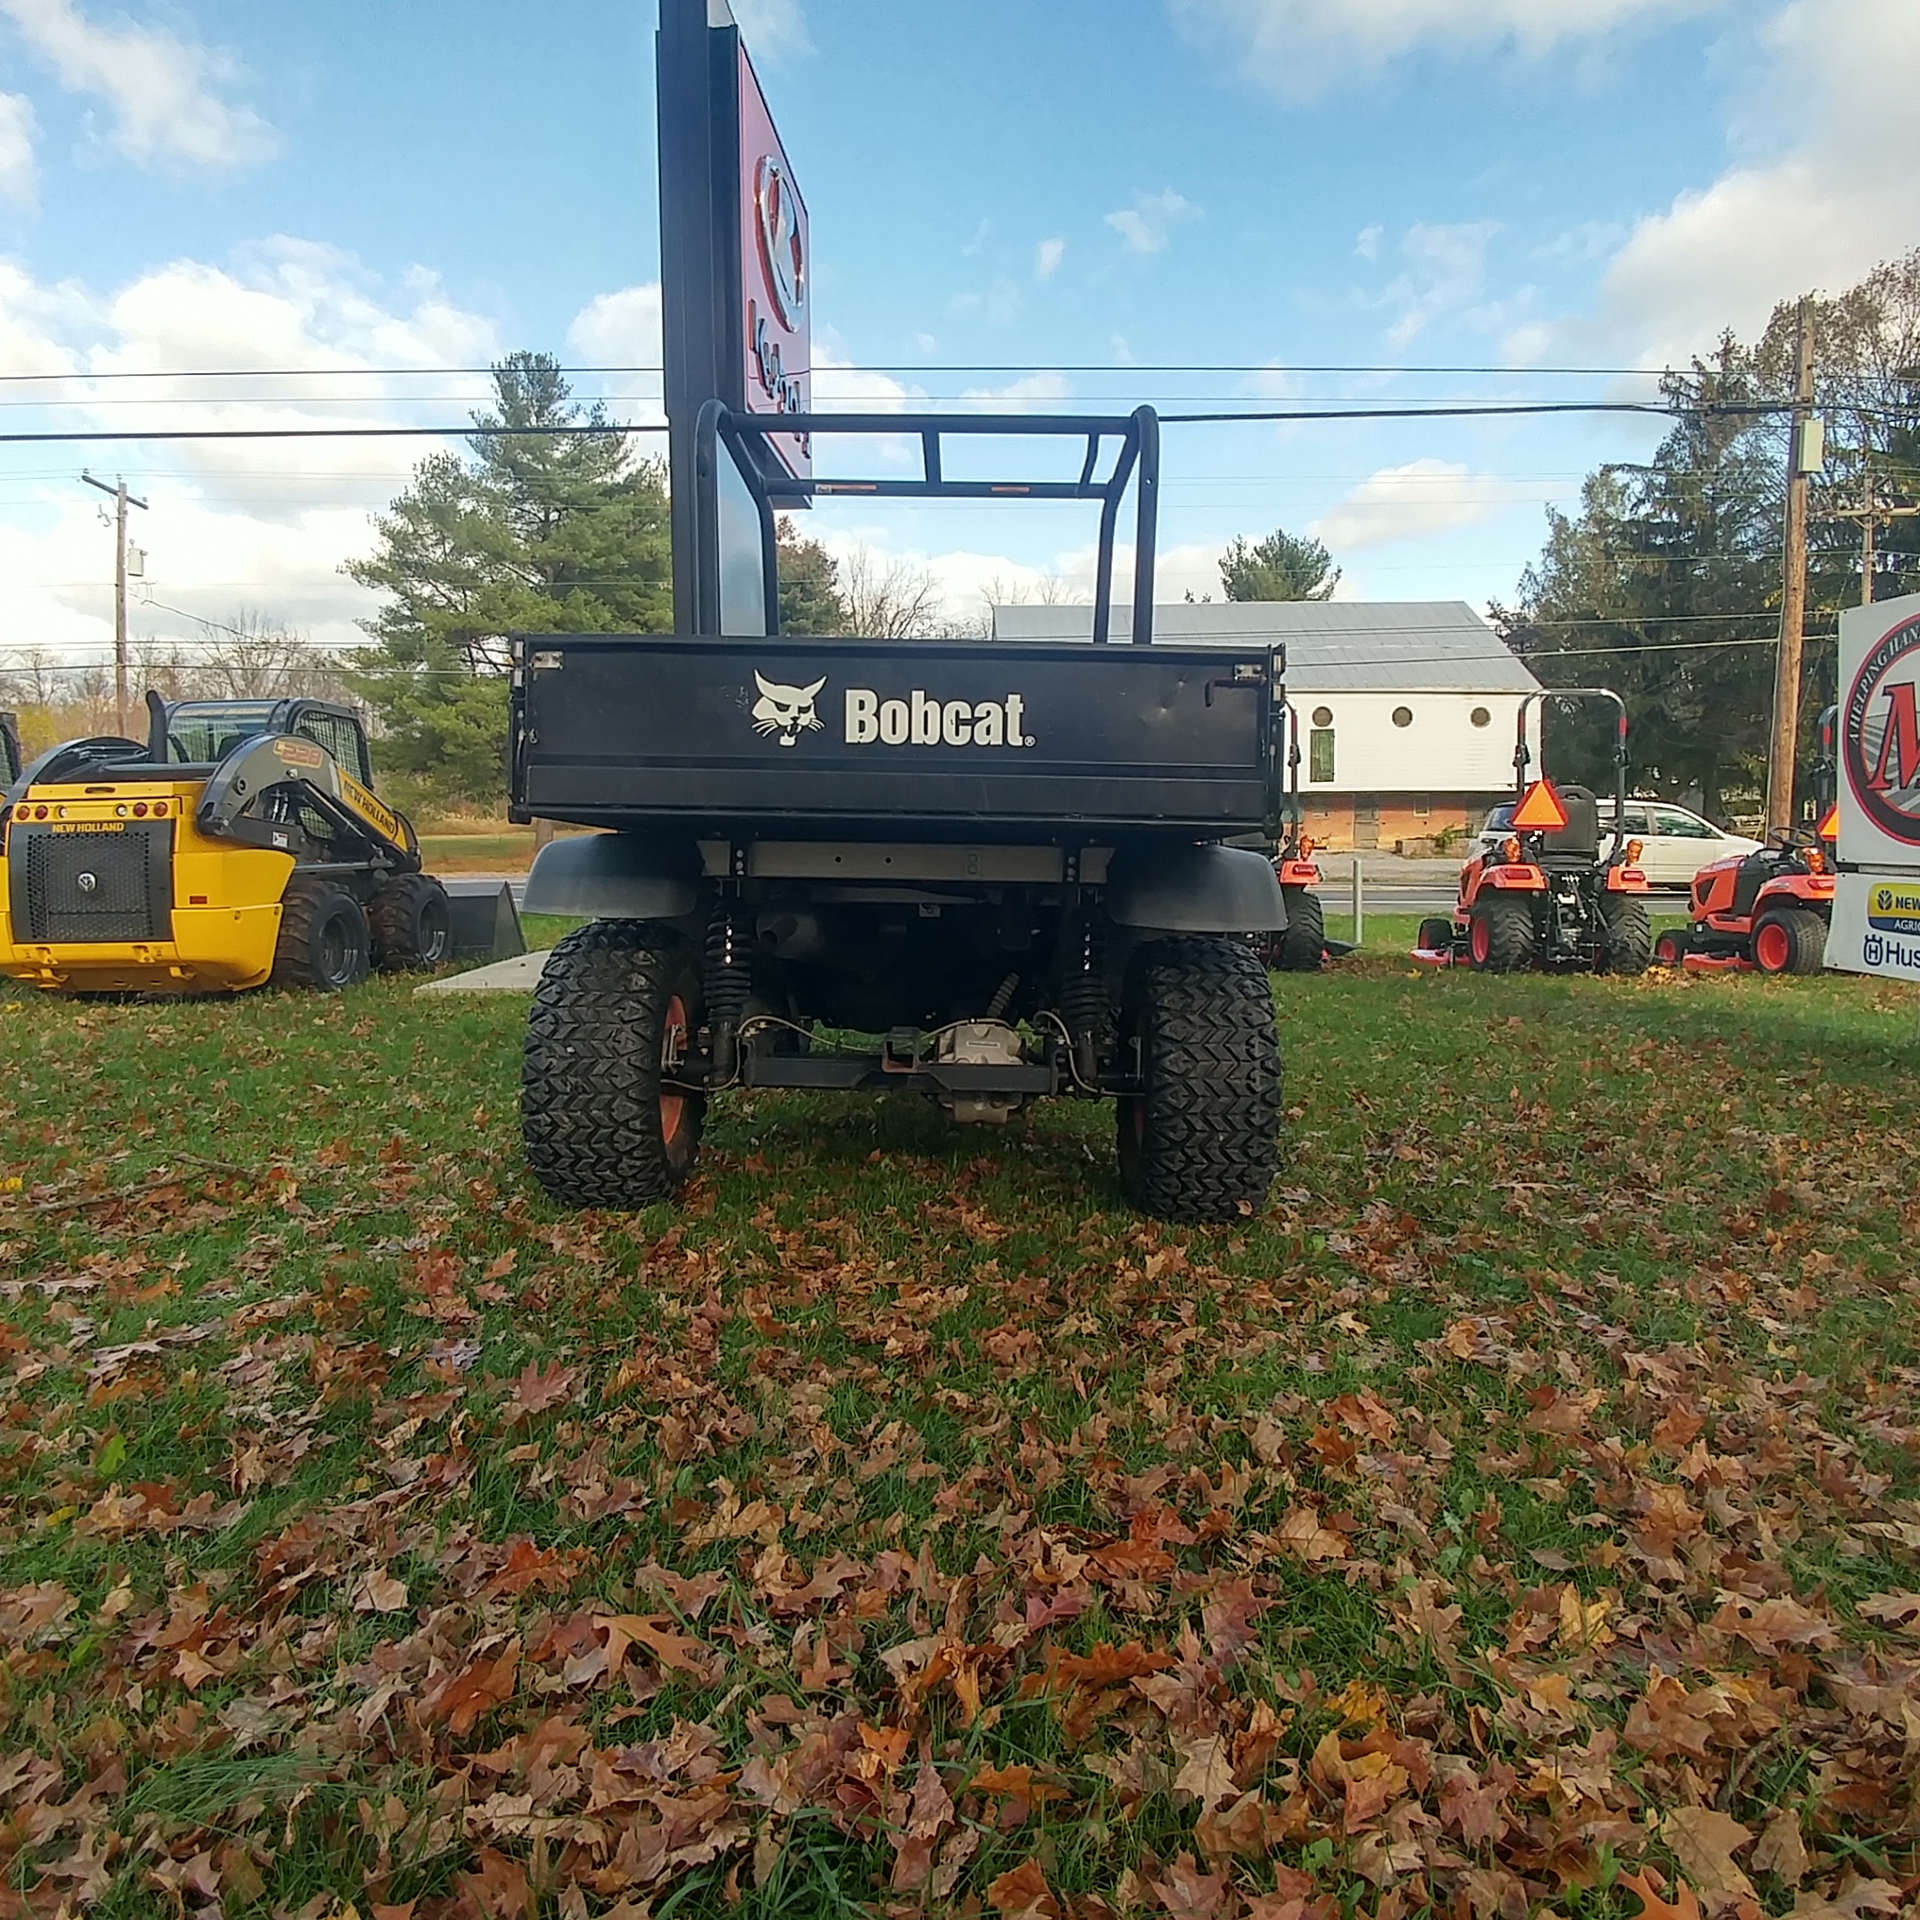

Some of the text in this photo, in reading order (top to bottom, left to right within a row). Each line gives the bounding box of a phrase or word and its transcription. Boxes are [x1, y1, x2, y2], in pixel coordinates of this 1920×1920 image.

[1849, 650, 1888, 729] HELPING
[845, 689, 1024, 746] Bobcat
[1848, 732, 1860, 746] A
[343, 780, 395, 834] NEW HOLLAND
[52, 822, 125, 833] NEW HOLLAND
[1895, 896, 1920, 911] NEW
